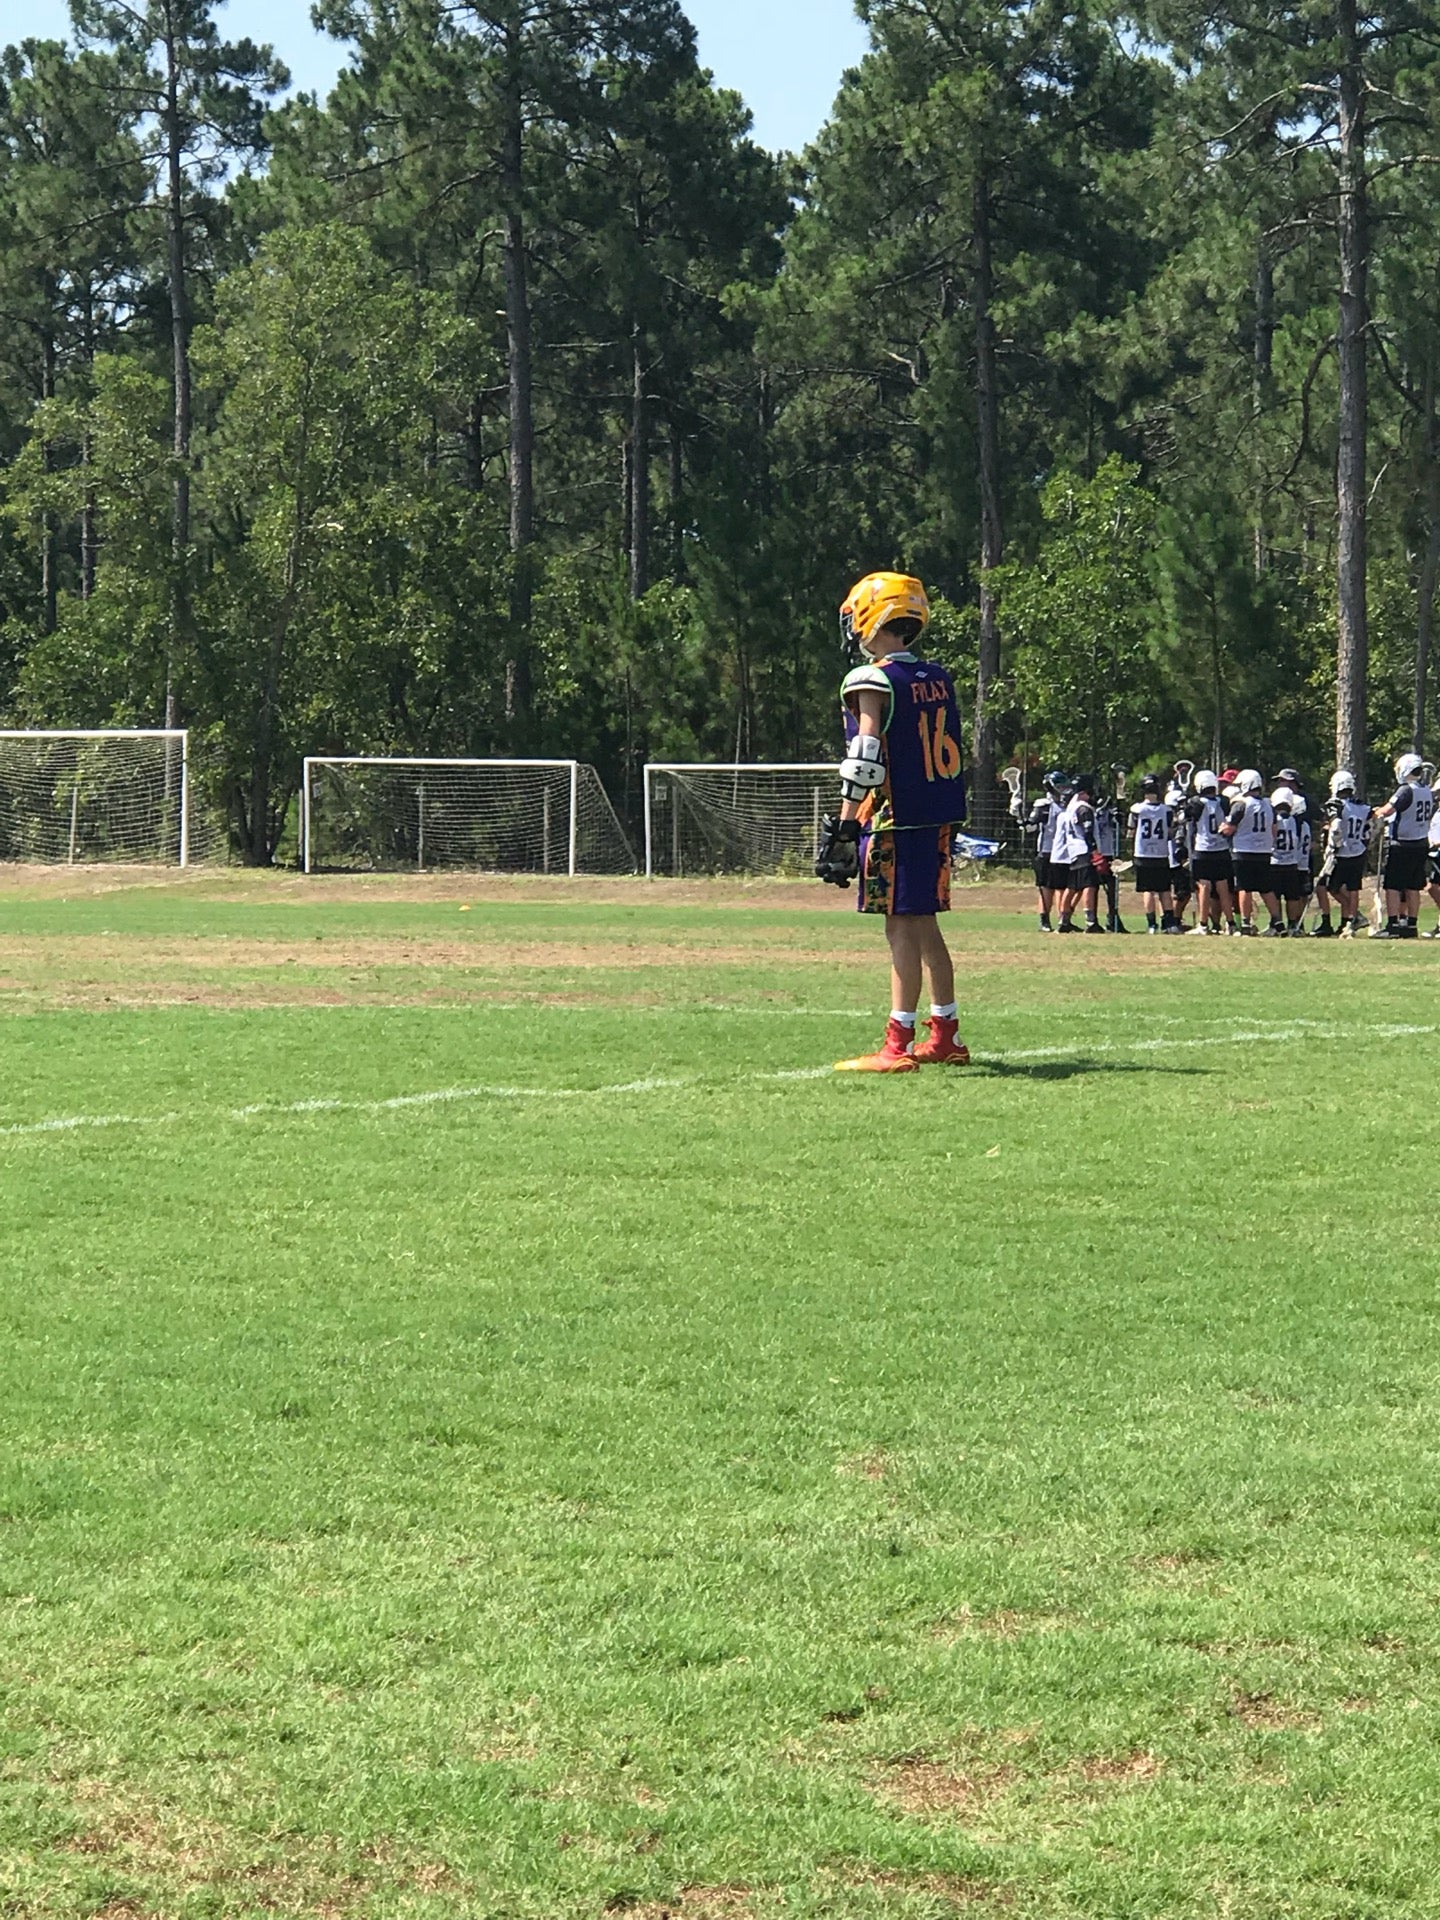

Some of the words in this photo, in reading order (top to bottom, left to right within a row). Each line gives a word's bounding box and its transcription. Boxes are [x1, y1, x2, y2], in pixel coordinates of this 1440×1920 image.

[917, 705, 961, 783] 16
[1141, 818, 1164, 840] 34
[1252, 812, 1266, 833] 11
[1276, 829, 1294, 850] 21
